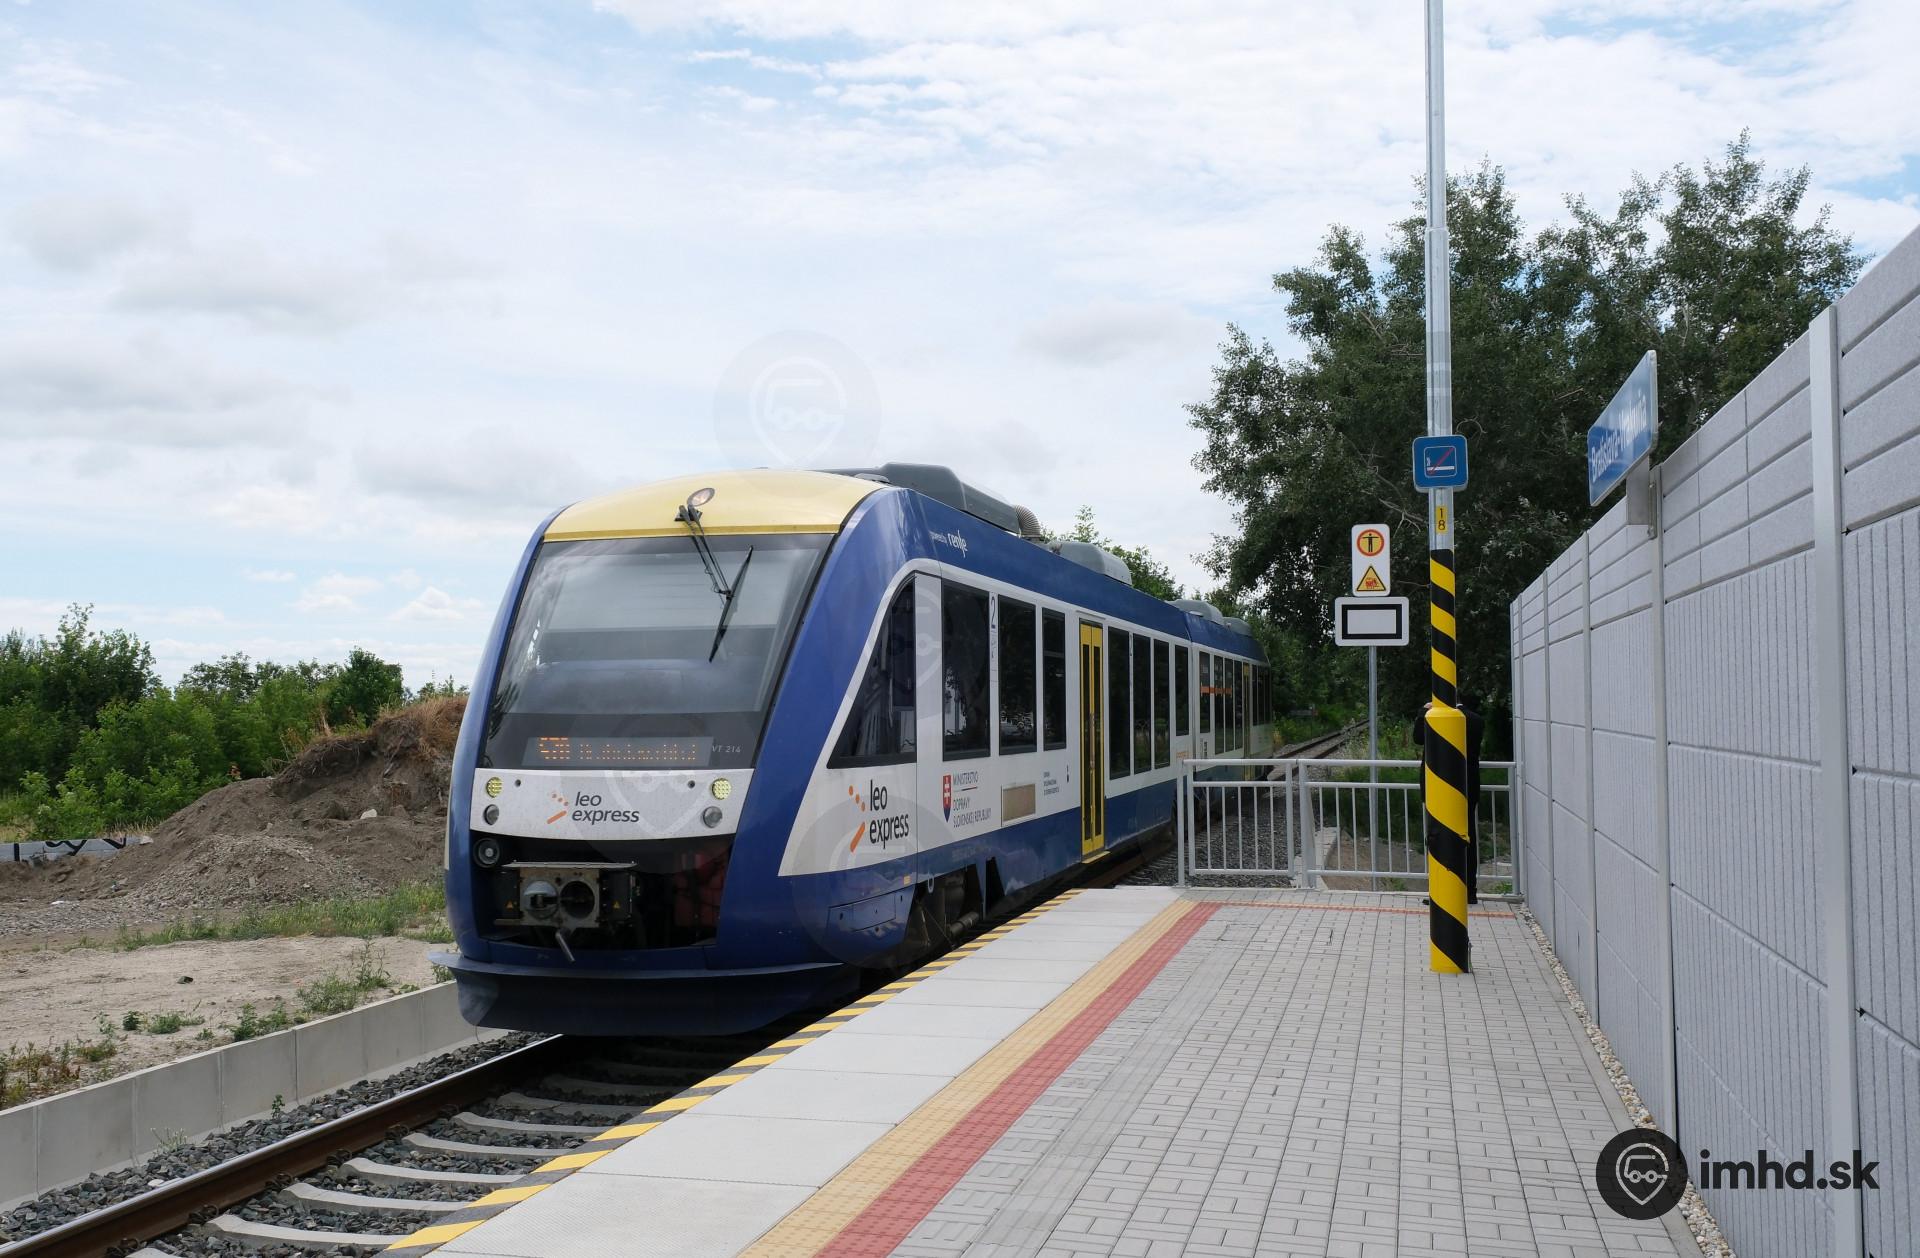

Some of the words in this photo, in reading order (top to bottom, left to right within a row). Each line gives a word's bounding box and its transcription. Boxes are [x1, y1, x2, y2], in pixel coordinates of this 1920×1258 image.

[574, 791, 603, 807] leo
[870, 779, 888, 812] leo
[571, 808, 640, 826] express
[869, 814, 910, 850] express
